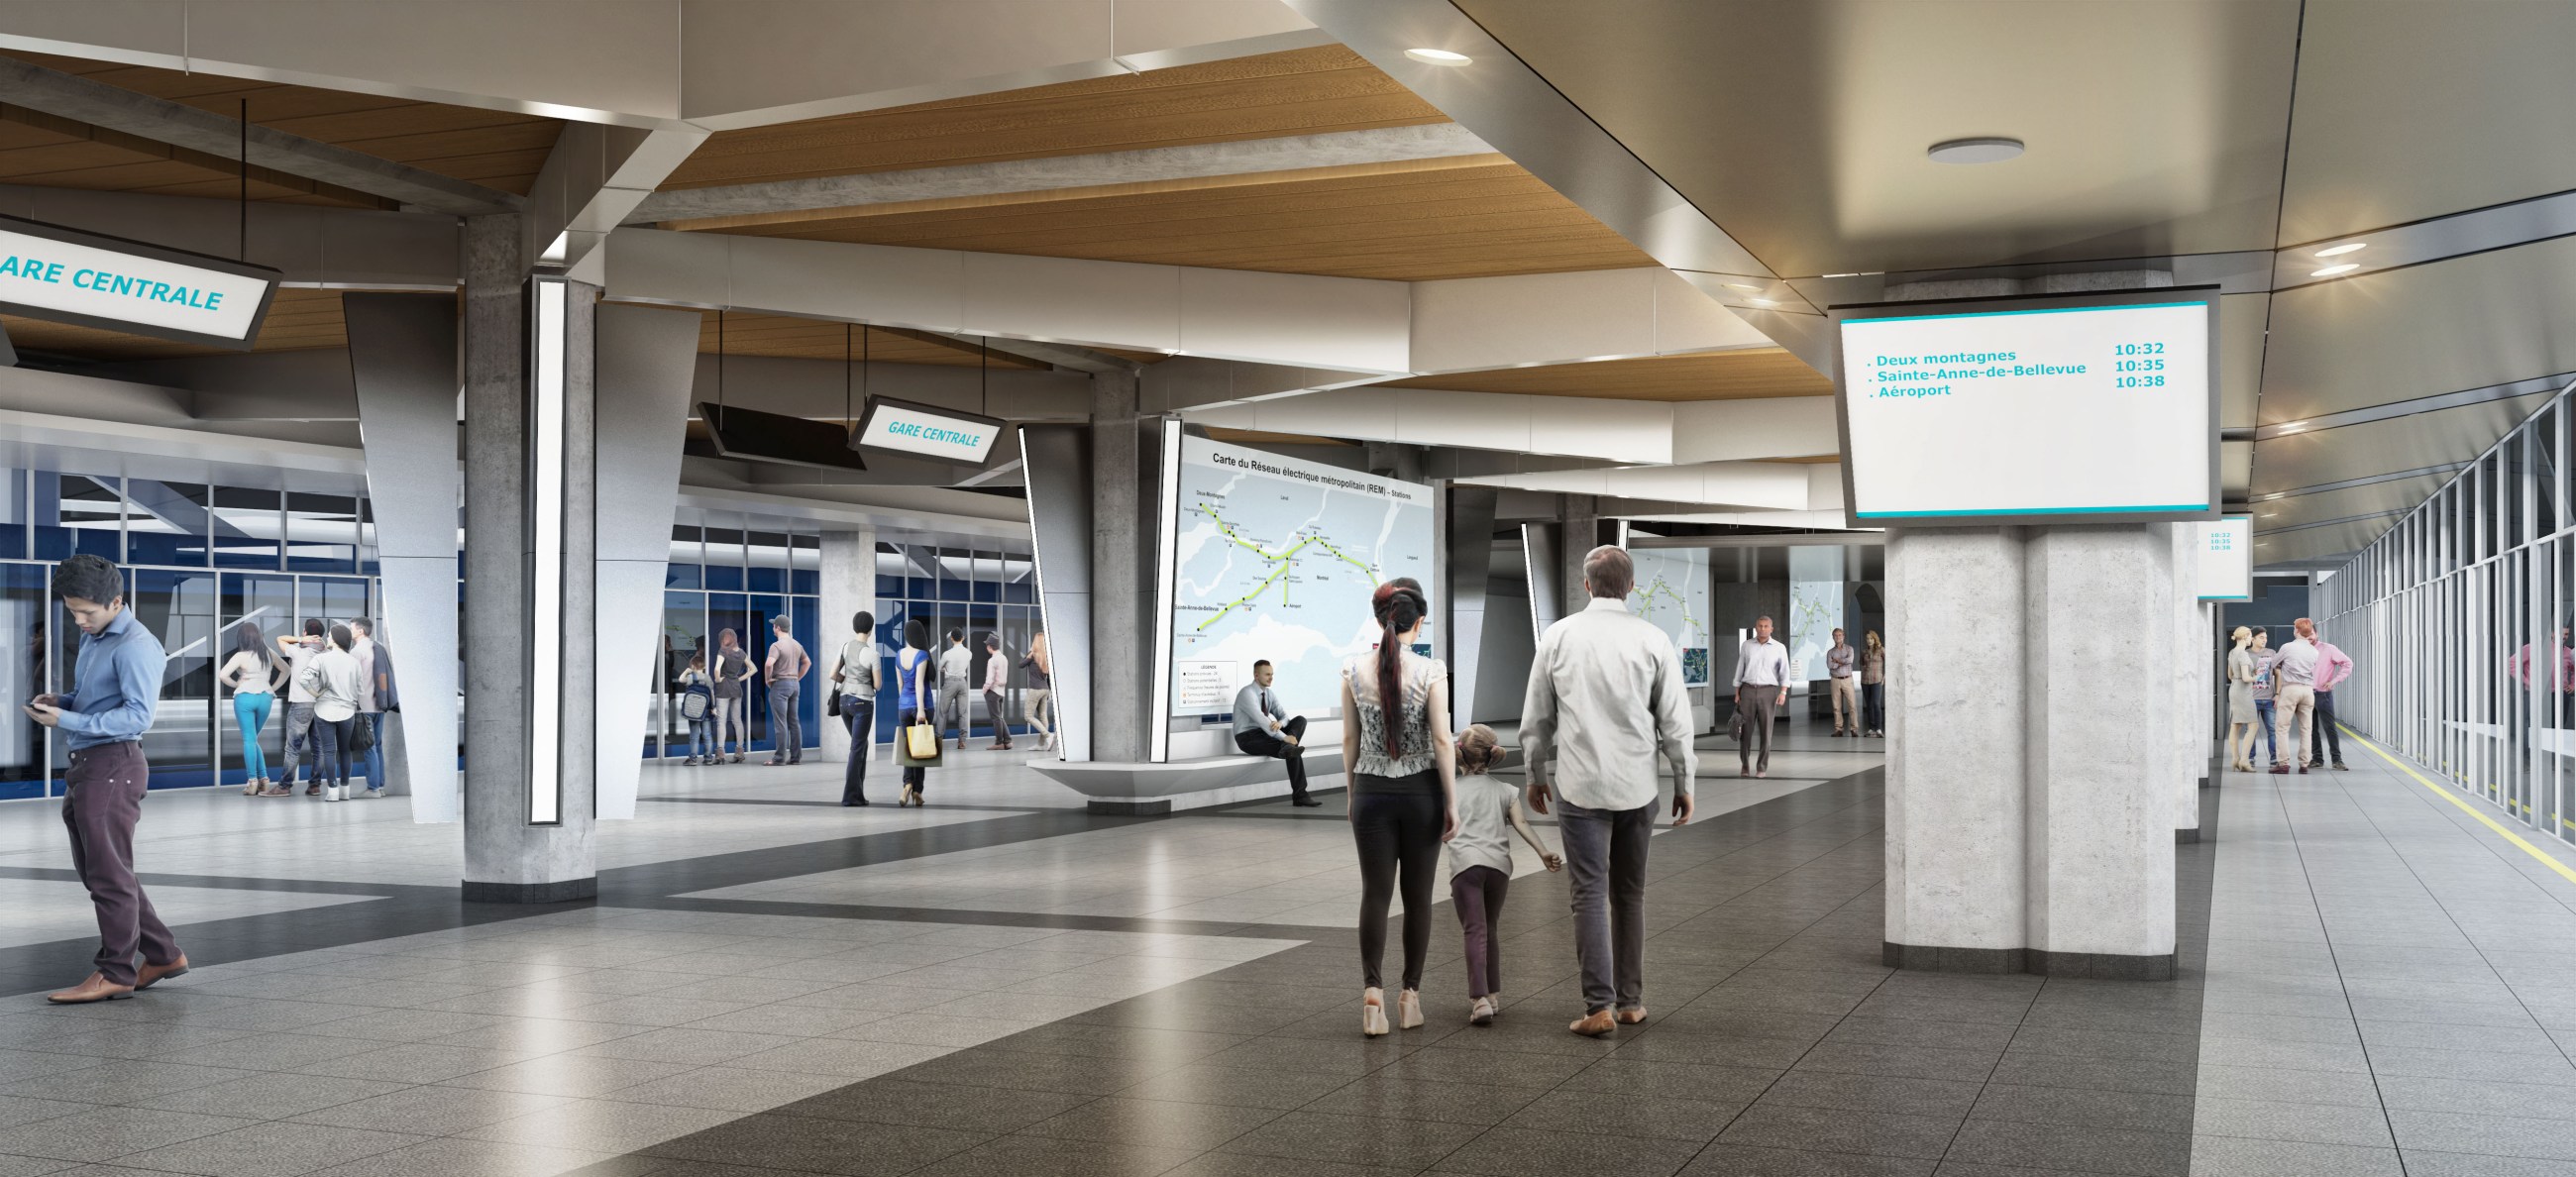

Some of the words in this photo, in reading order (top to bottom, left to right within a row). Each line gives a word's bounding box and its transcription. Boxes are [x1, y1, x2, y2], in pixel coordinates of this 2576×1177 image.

[71, 268, 224, 311] CENTRALE
[1877, 354, 1918, 368] Deux
[1923, 351, 2017, 366] montagnes
[2114, 342, 2165, 357] 10:32
[1877, 364, 2087, 383] Sainte-Anne-de-Bellevue
[2115, 358, 2165, 373] 10:35
[1878, 384, 1952, 399] Aéroport
[2115, 374, 2165, 389] 10:38
[888, 421, 921, 438] GARE
[922, 426, 981, 447] CENTRALE
[1213, 453, 1236, 467] Carte
[1237, 458, 1249, 469] du
[1250, 460, 1281, 475] Réseau
[1282, 466, 1320, 482] électrique
[1321, 475, 1366, 491] métropolitain
[1366, 482, 1386, 496] (REM)
[1391, 489, 1412, 500] Stations
